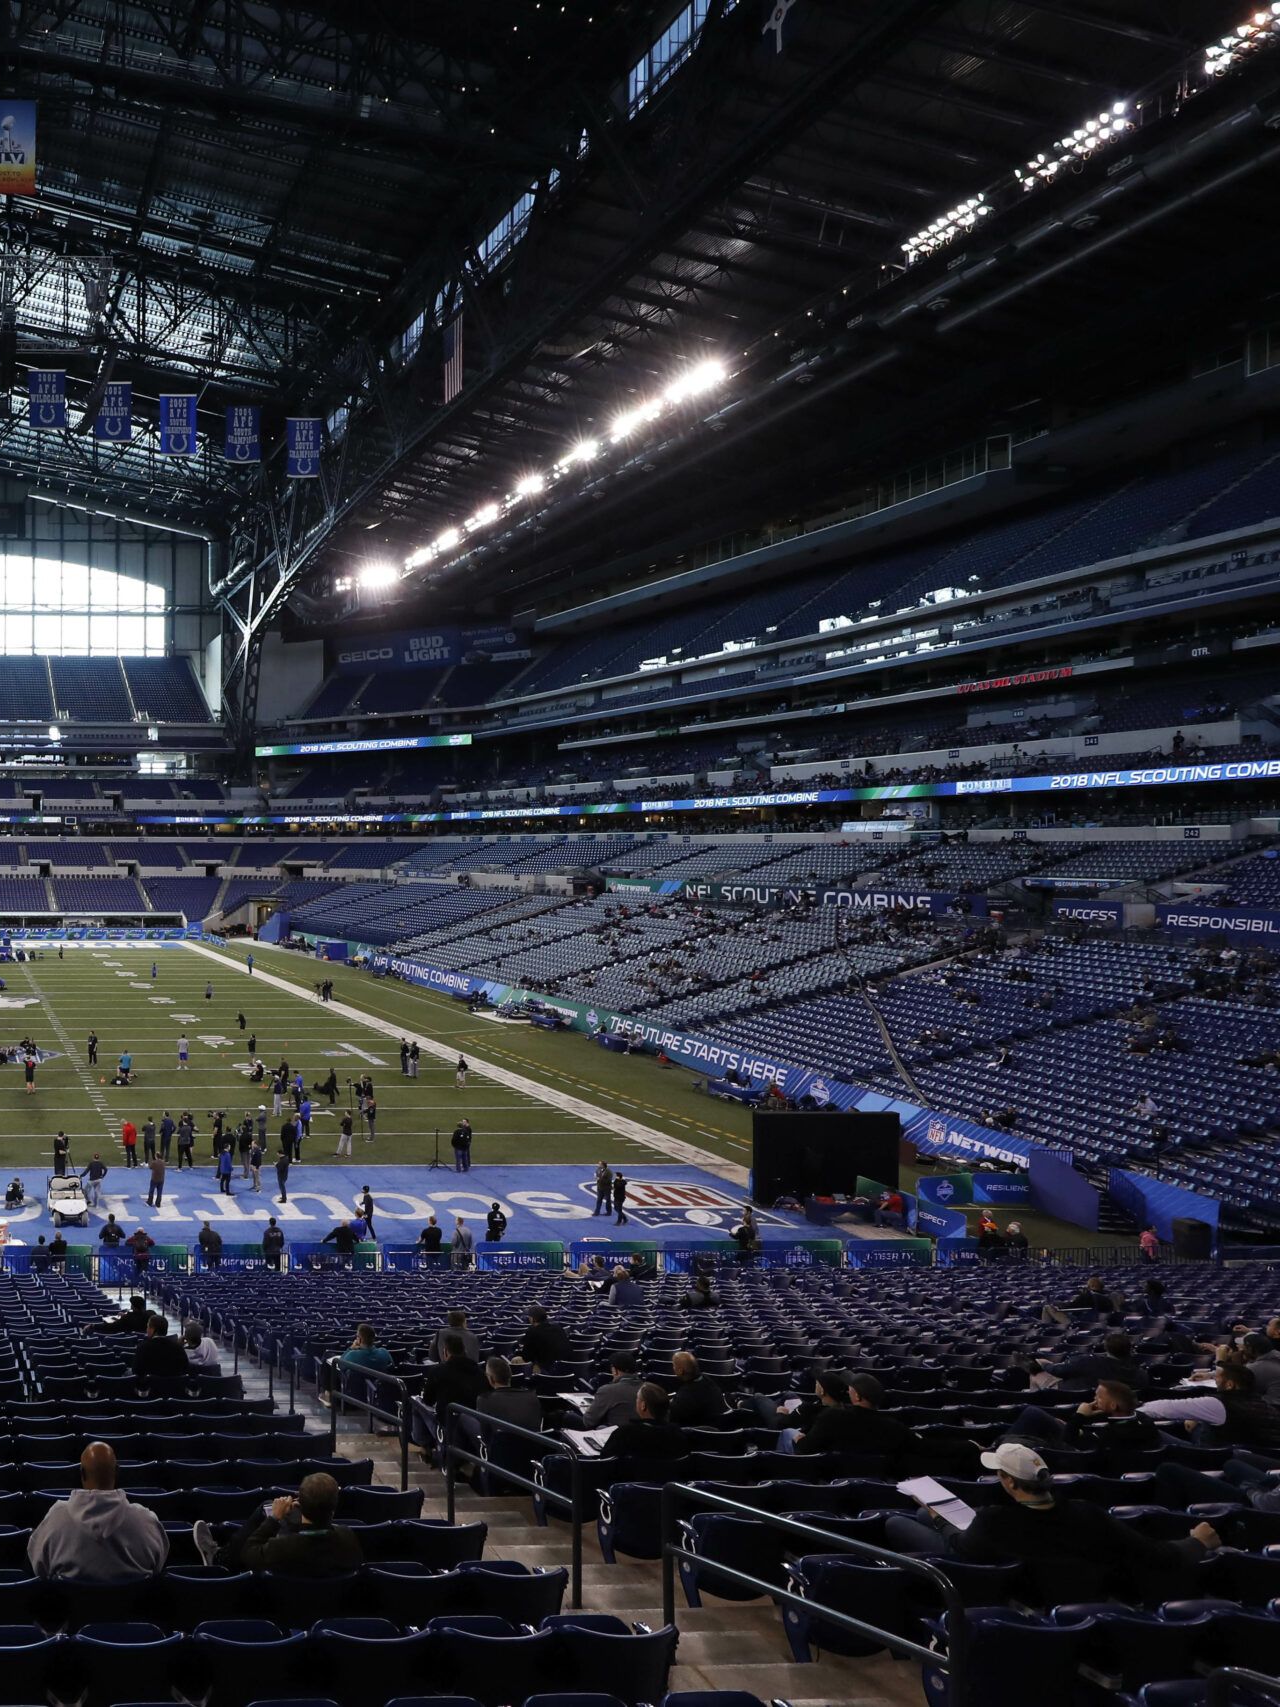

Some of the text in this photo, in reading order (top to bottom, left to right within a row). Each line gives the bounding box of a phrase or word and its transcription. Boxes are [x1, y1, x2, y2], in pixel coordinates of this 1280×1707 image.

[38, 384, 57, 394] AFC
[31, 394, 64, 403] WILDCARD
[103, 397, 123, 407] AFC
[170, 409, 187, 417] AFC
[233, 416, 253, 428] AFC
[228, 434, 258, 445] CHAMPIONS
[295, 430, 314, 442] AFC
[295, 442, 314, 450] SOUTH
[410, 635, 444, 650] BUD
[338, 647, 393, 664] GEICO
[404, 646, 451, 664] LIGHT
[1014, 666, 1072, 686] STADIUM
[300, 739, 418, 753] 2018 NFL SCOUTING COMBINE
[1051, 775, 1087, 789] 2018
[1091, 772, 1123, 787] NFL
[1130, 764, 1221, 784] SCOUTING
[694, 792, 819, 808] 2018 NFL SCOUTING COMBINE
[481, 807, 560, 818] 2018 NFL SCOUTING COMBINE
[1184, 829, 1199, 837] 242
[1166, 914, 1280, 934] RESPONSIBIL
[373, 955, 470, 991] NFL SCOUTING COMBINE
[634, 1024, 680, 1051] FUTURE
[683, 1039, 738, 1068] STARTS
[741, 1057, 788, 1086] HERE
[947, 1130, 1030, 1169] NETWOR
[986, 1184, 1029, 1193] RESILIENC
[919, 1211, 948, 1227] ESPECT
